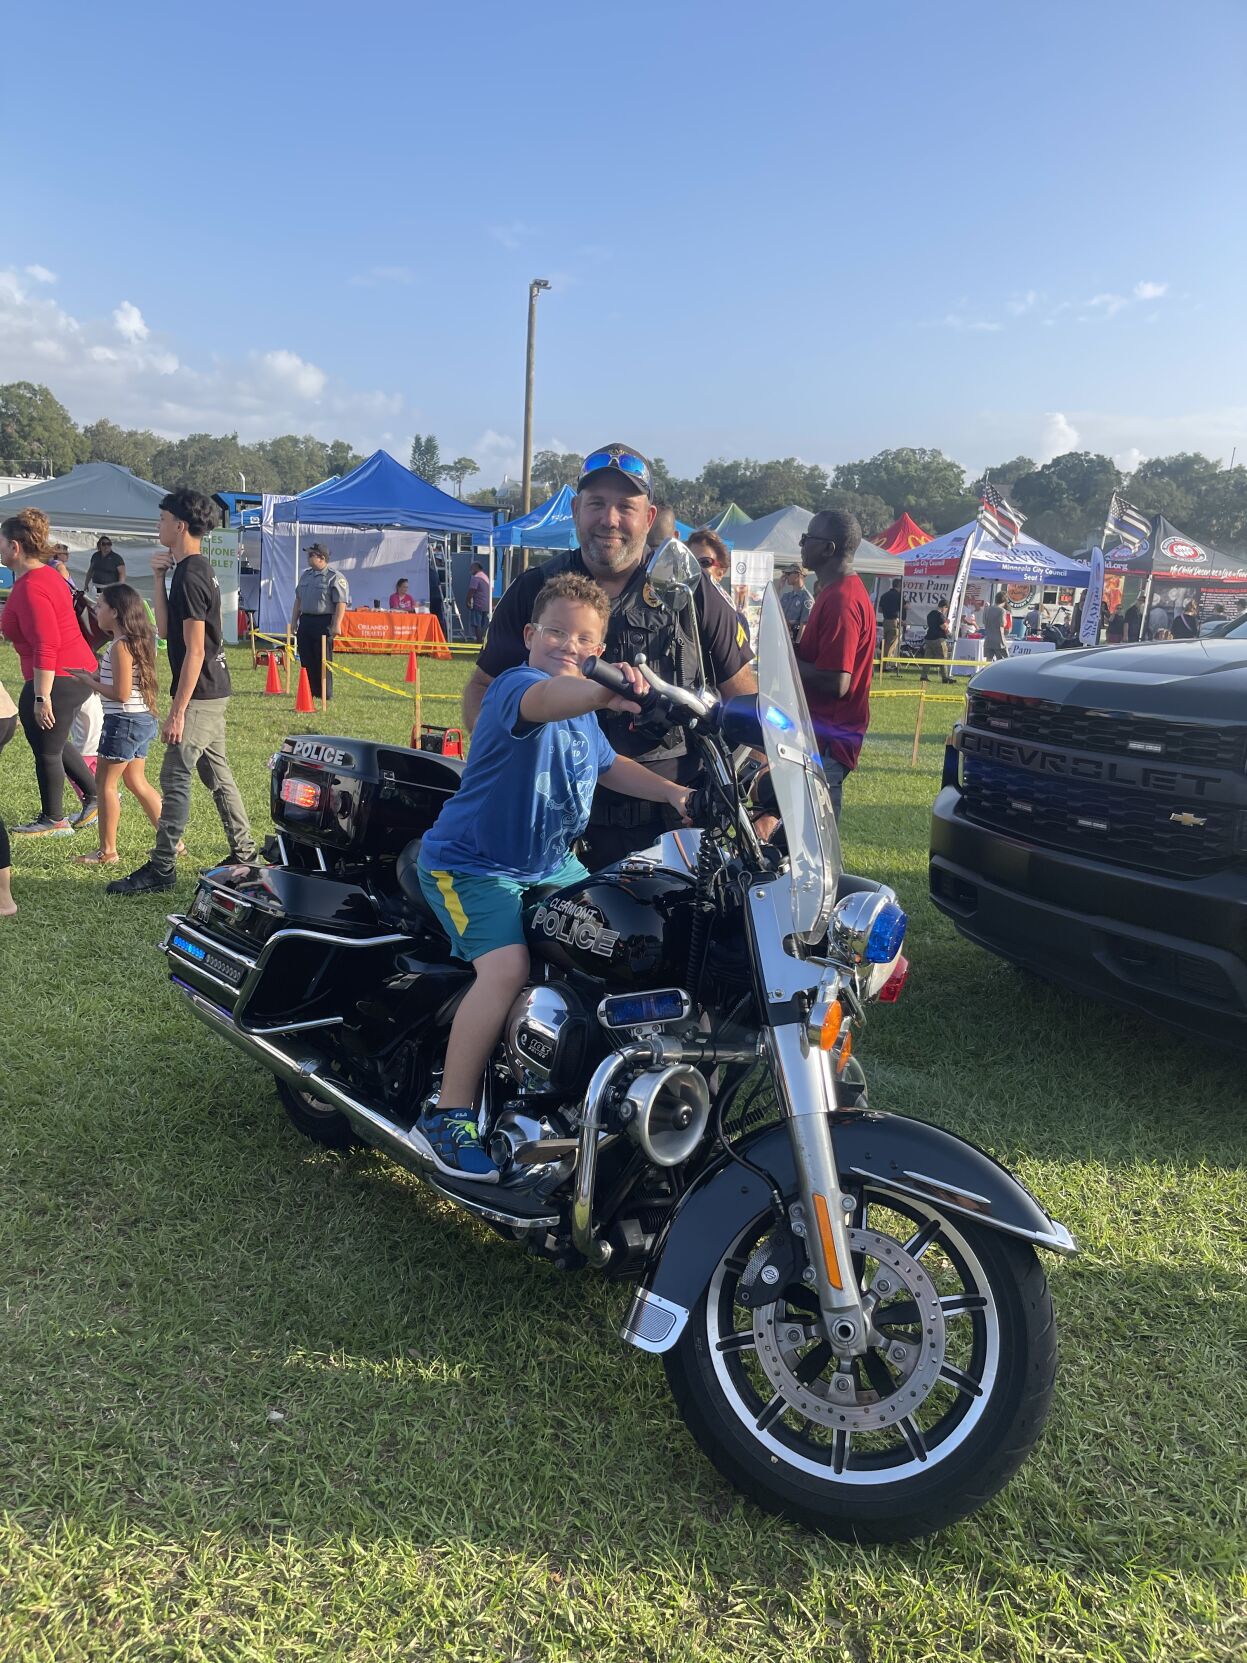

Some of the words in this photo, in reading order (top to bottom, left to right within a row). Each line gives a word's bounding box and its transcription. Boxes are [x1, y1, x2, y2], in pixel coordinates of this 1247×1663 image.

[1032, 566, 1044, 574] City
[1045, 568, 1067, 577] Council
[926, 580, 949, 591] Pam
[903, 591, 947, 604] ERVISS
[357, 623, 389, 631] ORLANDO
[1012, 644, 1032, 654] Pam
[293, 741, 346, 766] POLICE
[961, 733, 1221, 796] CHEVROLET
[549, 897, 598, 921] CLERMONT
[531, 905, 620, 957] POLICE
